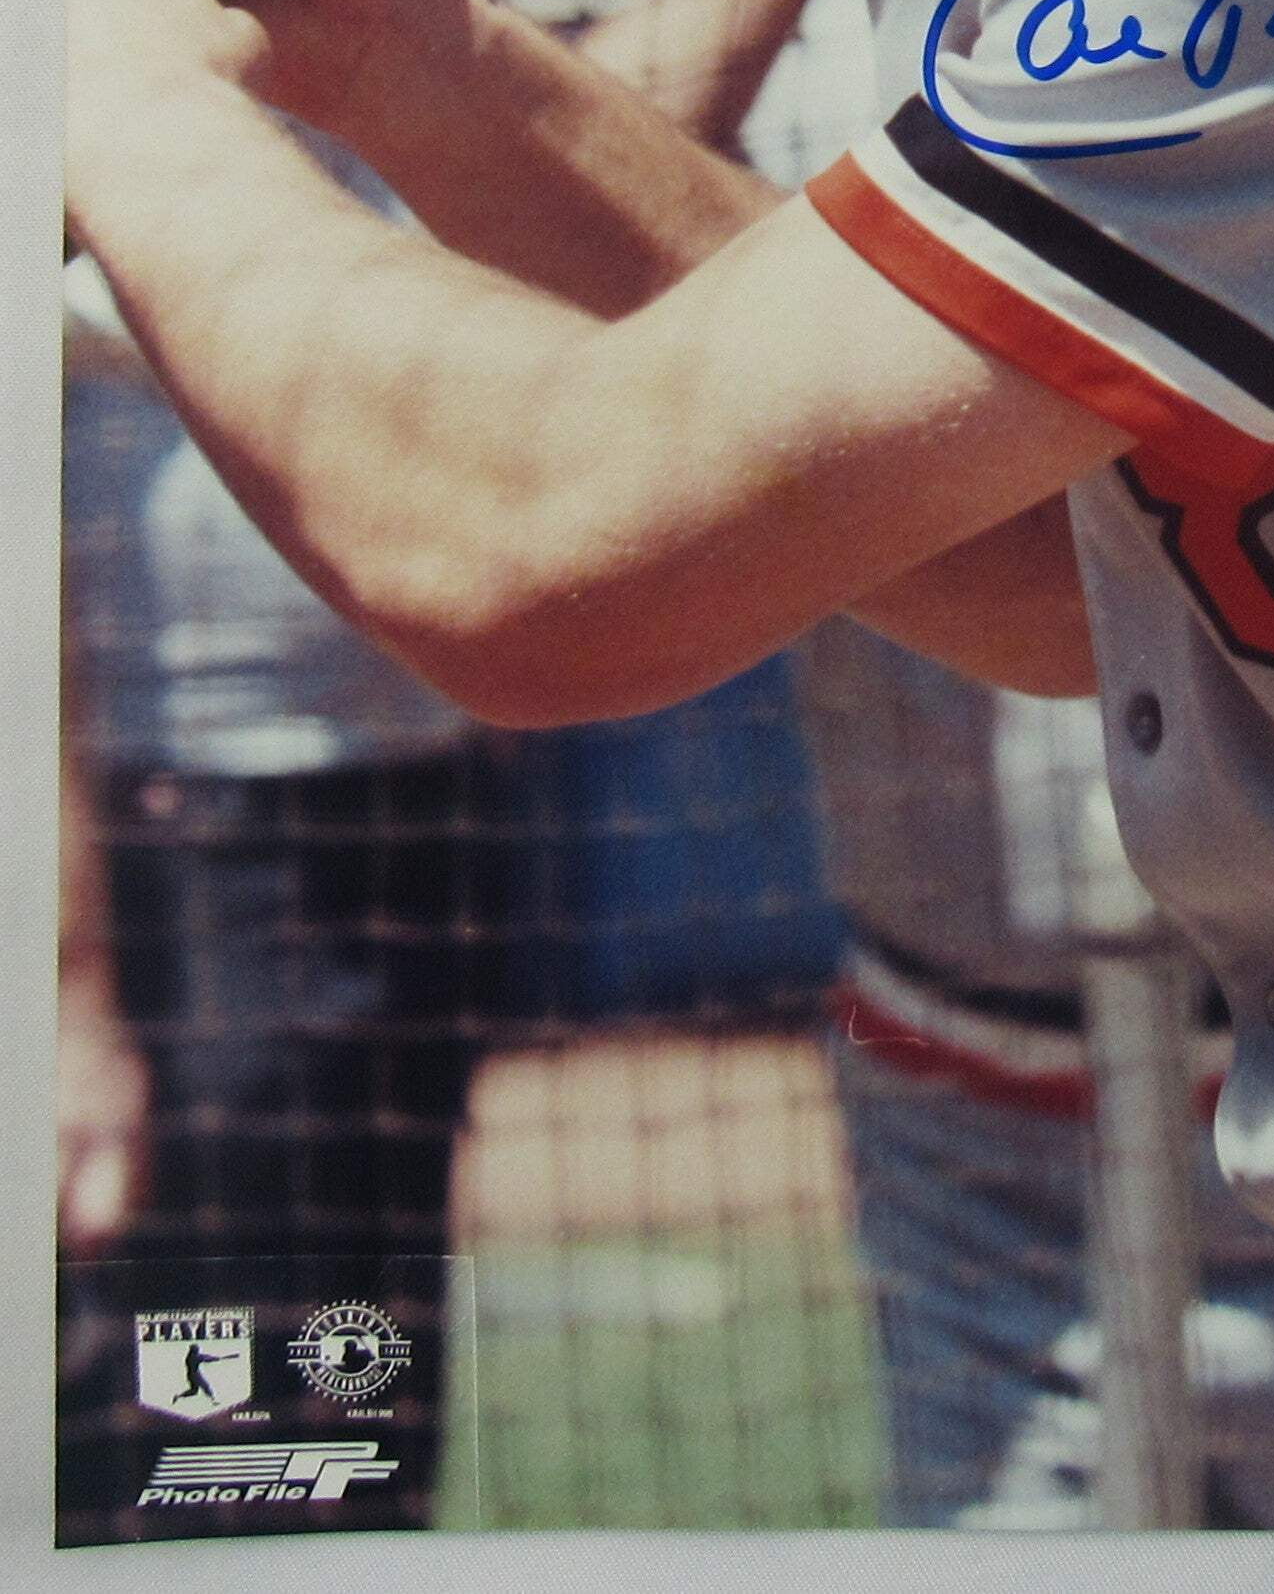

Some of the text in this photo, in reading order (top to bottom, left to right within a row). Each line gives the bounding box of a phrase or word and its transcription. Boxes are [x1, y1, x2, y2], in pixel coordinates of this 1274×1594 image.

[136, 1317, 251, 1342] PLAYERS
[136, 1483, 307, 1507] Photo File
